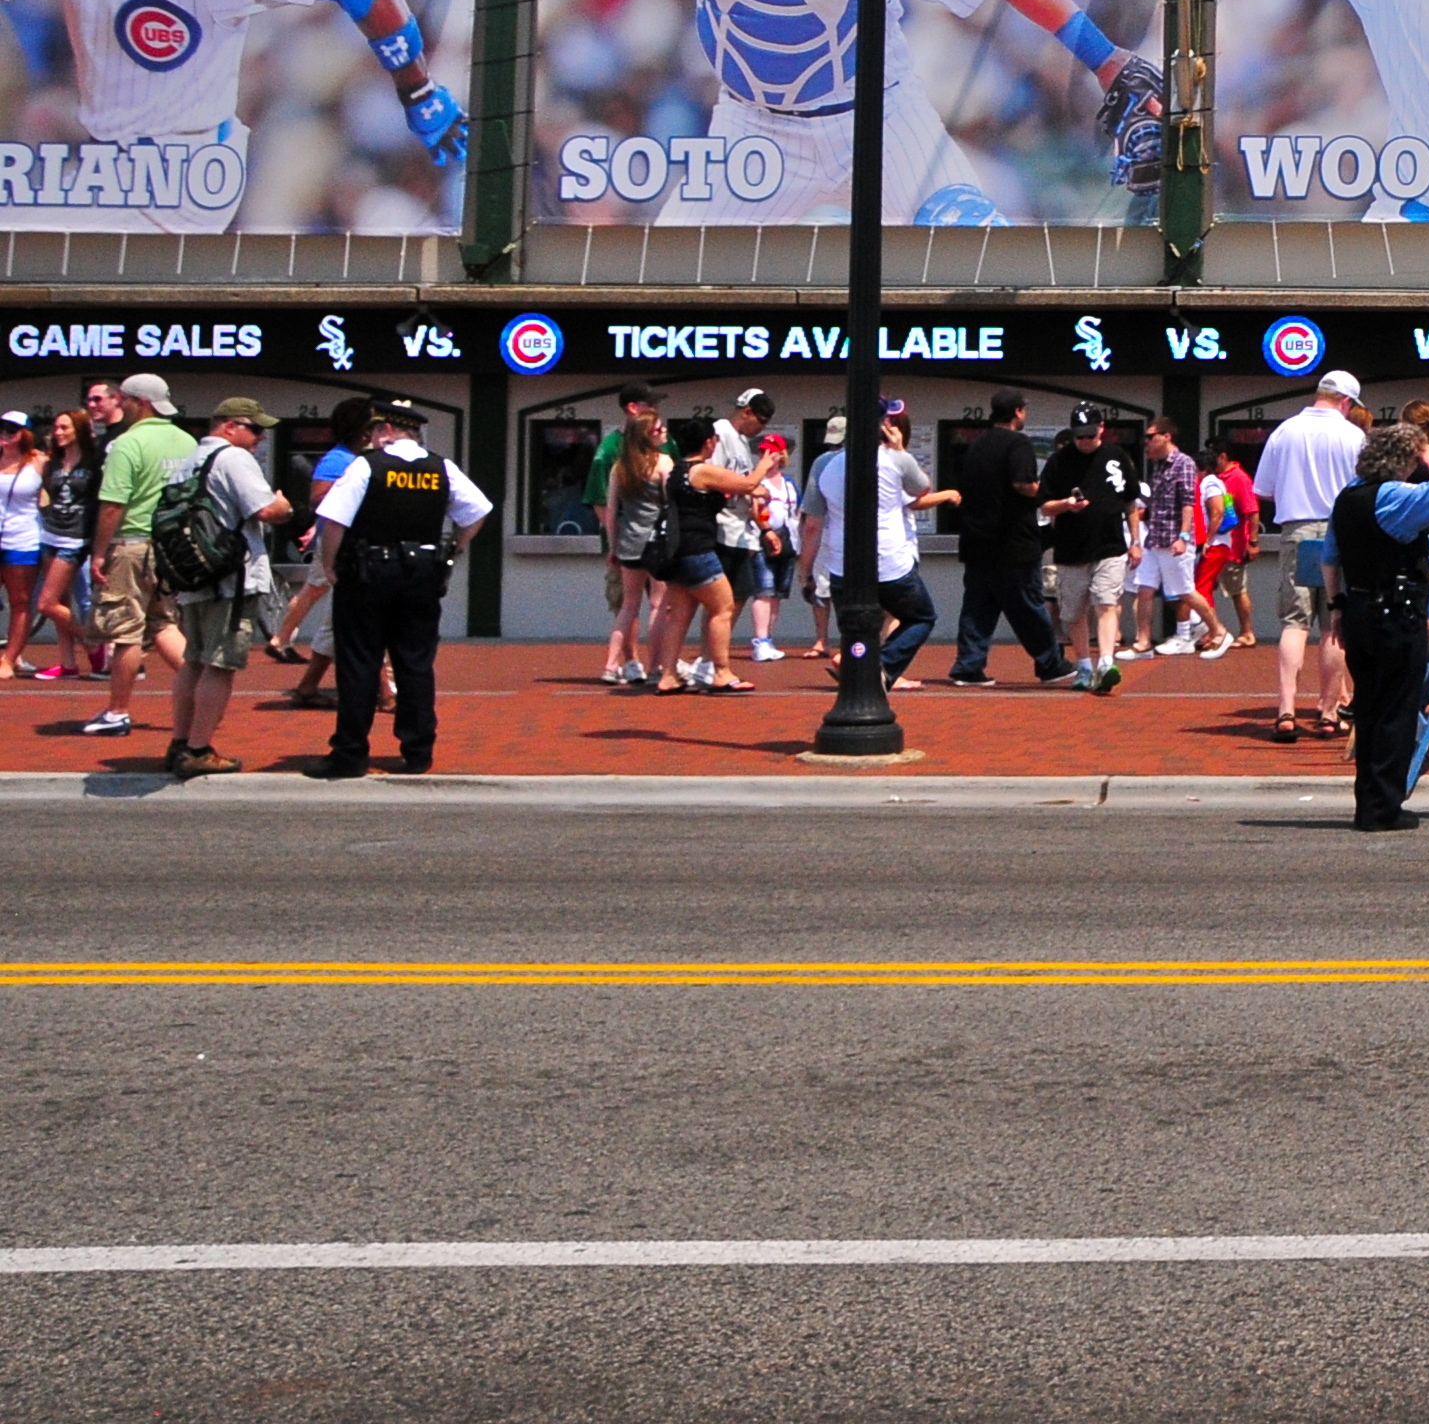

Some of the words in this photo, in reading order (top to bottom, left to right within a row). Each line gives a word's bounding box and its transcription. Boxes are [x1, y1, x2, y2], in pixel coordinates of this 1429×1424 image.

[0, 141, 247, 211] RIANO
[558, 133, 785, 204] SOTO
[9, 324, 125, 357] GAME
[135, 324, 263, 357] SALES
[402, 324, 461, 358] VS.
[608, 325, 770, 358] TICKETS
[780, 326, 1004, 359] AVLABLE
[1165, 327, 1227, 360] VS.
[386, 470, 440, 491] POLICE
